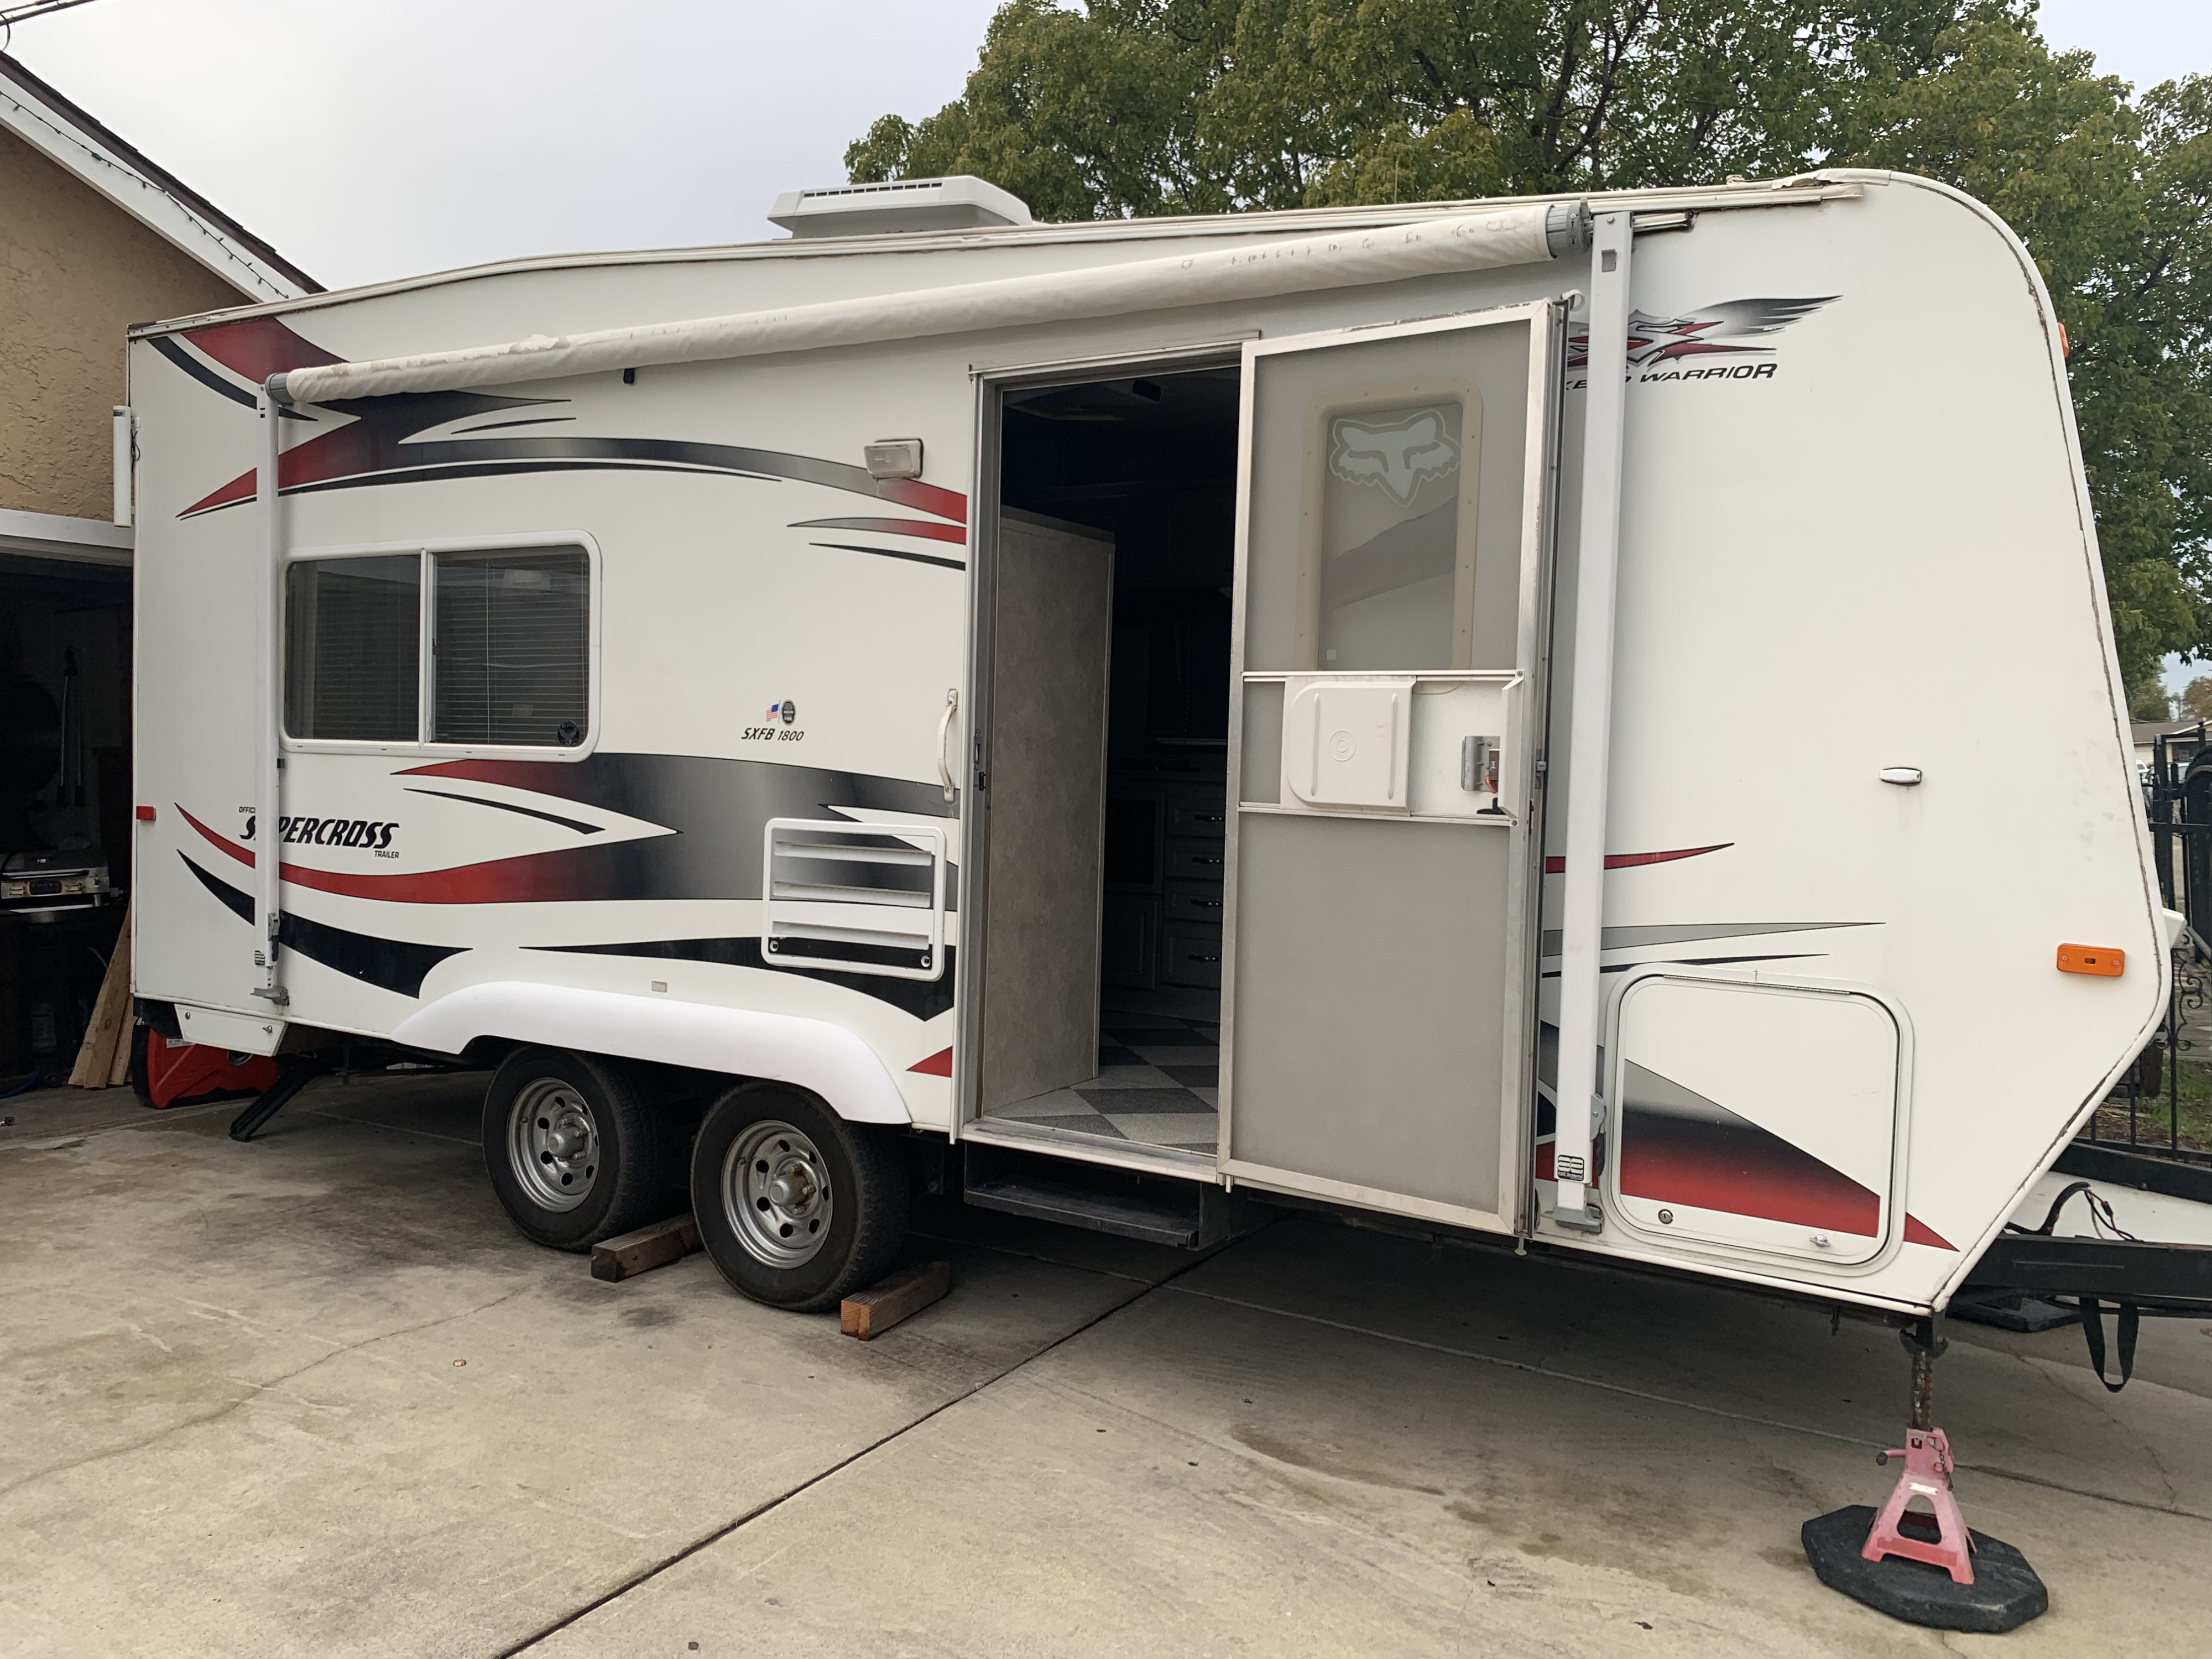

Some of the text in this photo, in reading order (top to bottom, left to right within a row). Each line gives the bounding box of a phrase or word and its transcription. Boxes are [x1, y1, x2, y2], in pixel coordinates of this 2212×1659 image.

[1640, 363, 1777, 383] WARRIOR
[741, 728, 804, 741] SXFB 1800
[239, 815, 400, 849] SPERCROSS
[374, 850, 399, 859] TRAILER
